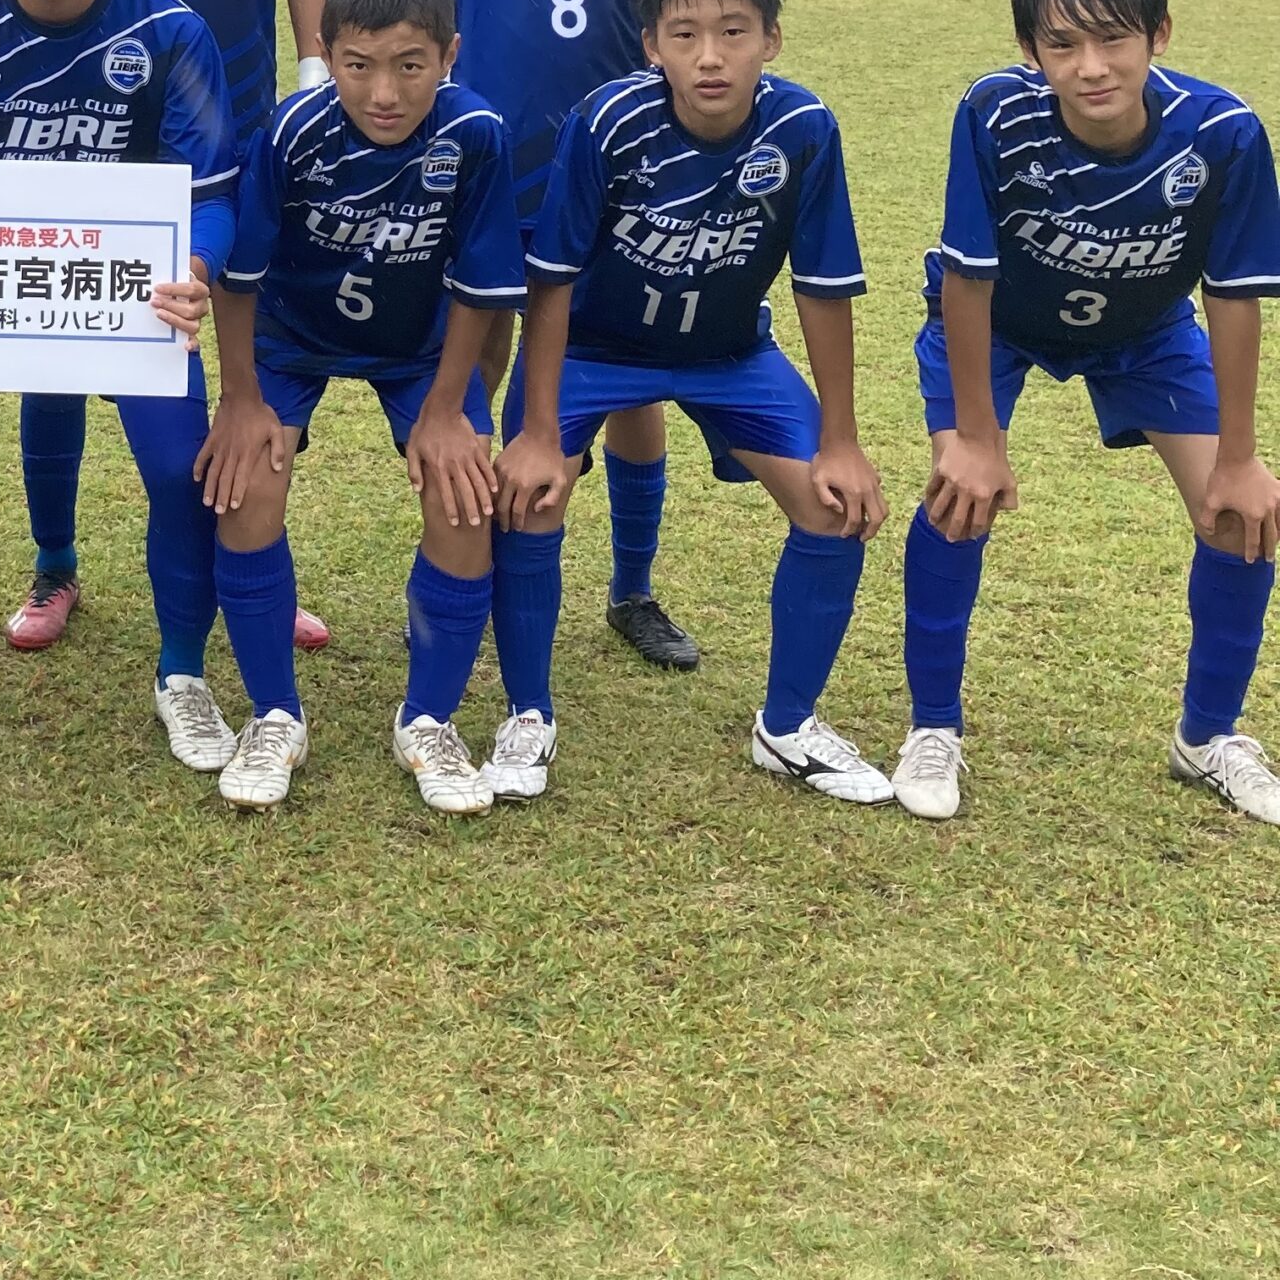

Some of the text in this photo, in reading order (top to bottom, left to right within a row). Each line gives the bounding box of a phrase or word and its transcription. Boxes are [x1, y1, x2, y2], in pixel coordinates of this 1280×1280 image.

[110, 61, 147, 74] LIBRE
[85, 99, 128, 115] CLUB
[76, 150, 121, 163] 2016
[743, 164, 781, 181] LIBRE
[320, 201, 442, 219] FOOTBAL CLUB
[637, 203, 759, 231] FOOTBL CLUB
[1039, 208, 1183, 240] FOOTBALL CLUB
[305, 216, 448, 251] LIBRE
[612, 213, 763, 263] LIBRE
[1015, 218, 1187, 269] LIBRE
[309, 235, 432, 264] FUKUOA 2016
[703, 254, 748, 274] 2016
[1020, 244, 1171, 280] FUKUOKA 2016
[335, 271, 374, 321] 5
[642, 281, 700, 333] 11
[1059, 289, 1108, 327] 3
